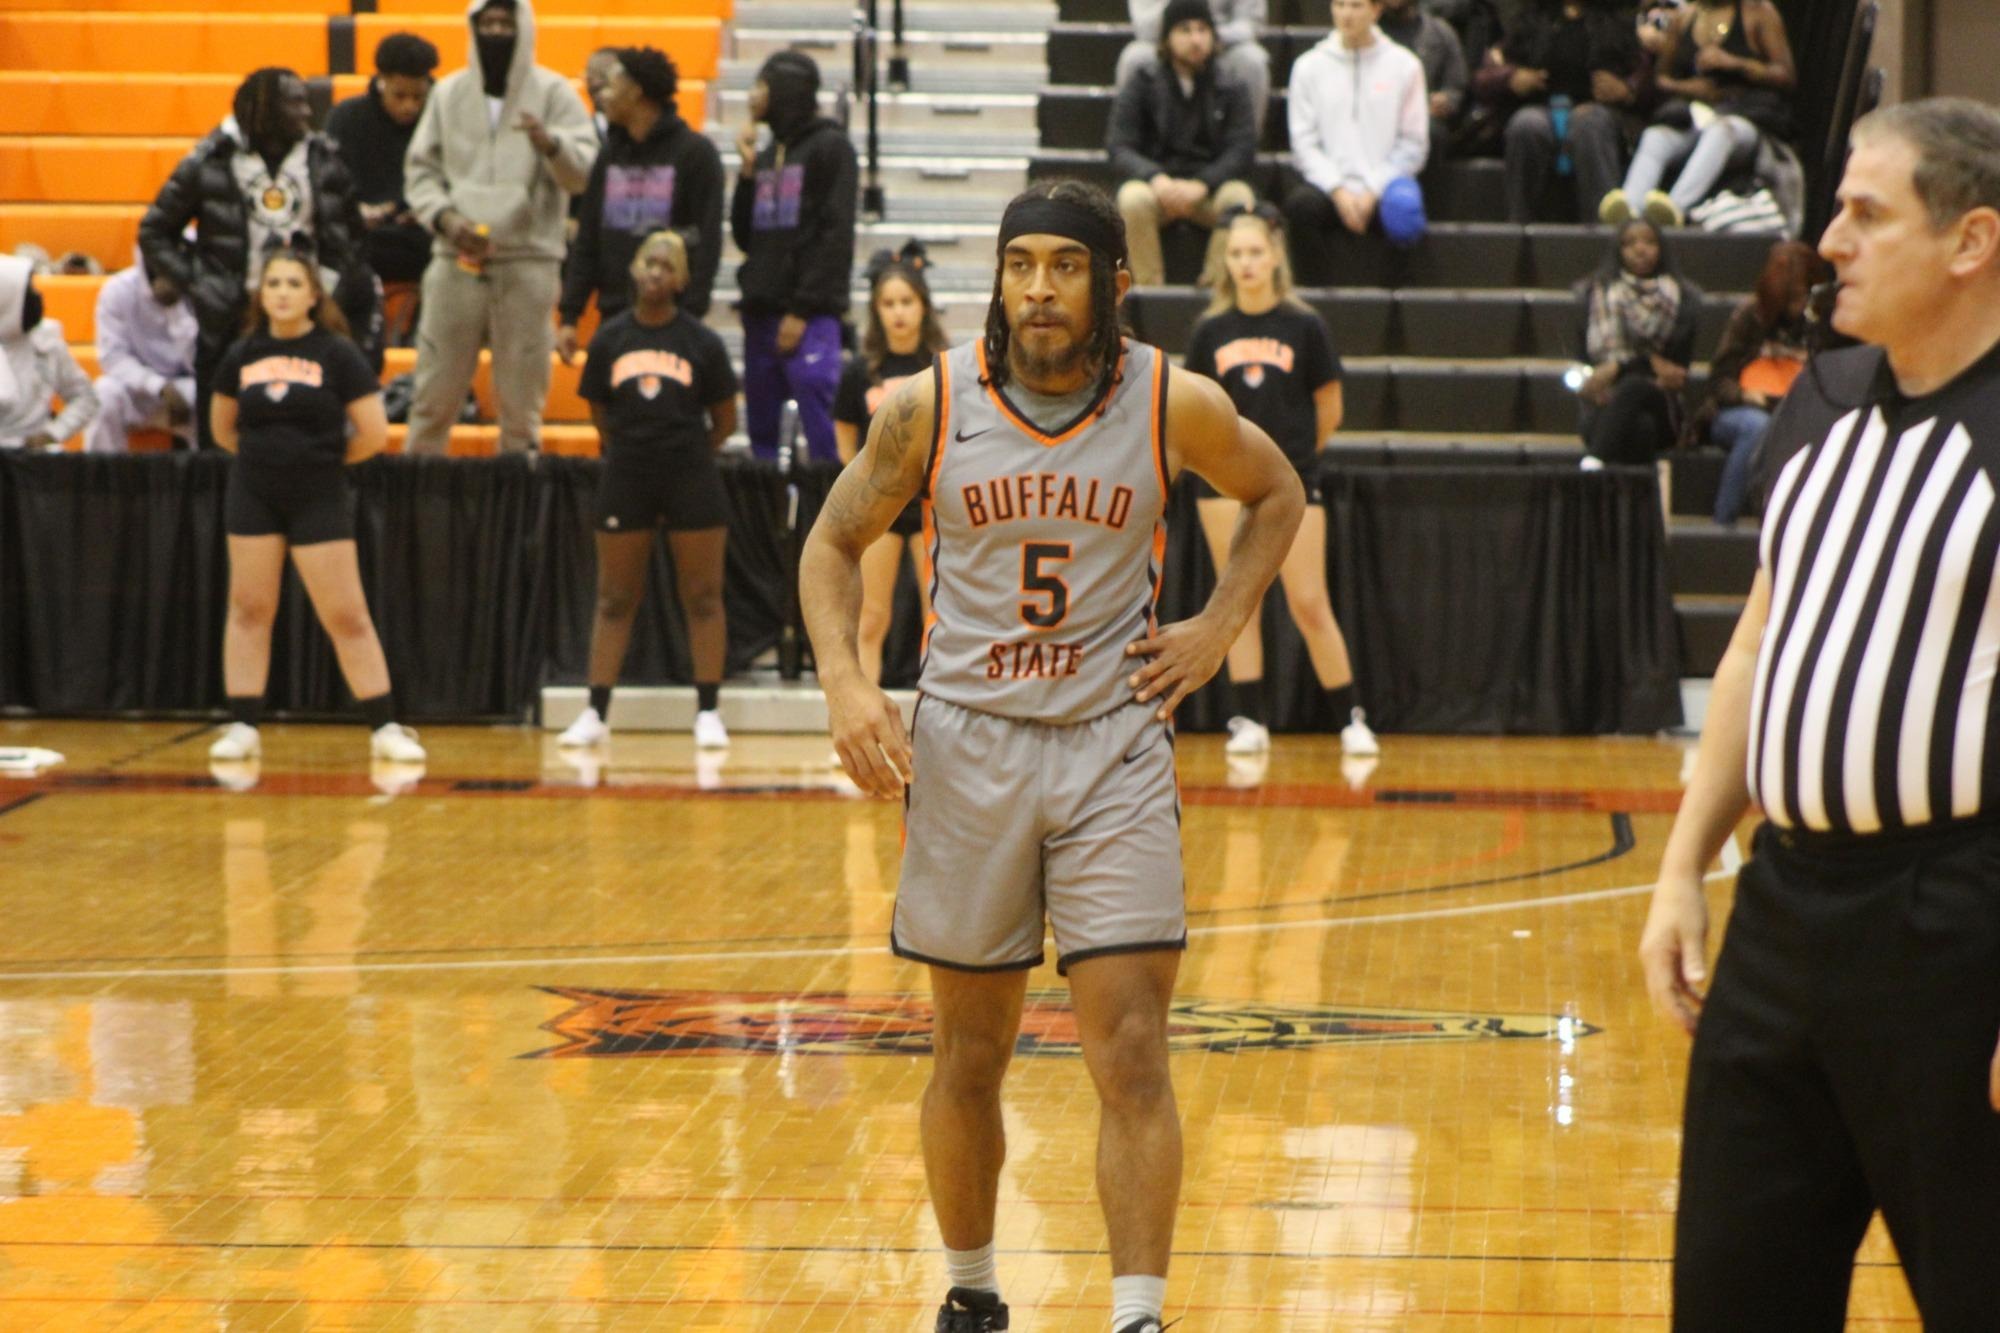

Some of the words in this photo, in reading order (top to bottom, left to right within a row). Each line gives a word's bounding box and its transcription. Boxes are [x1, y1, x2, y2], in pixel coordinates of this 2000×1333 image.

[962, 473, 1134, 530] BUFFALO
[1019, 539, 1074, 632] 5
[986, 641, 1083, 681] STATE
